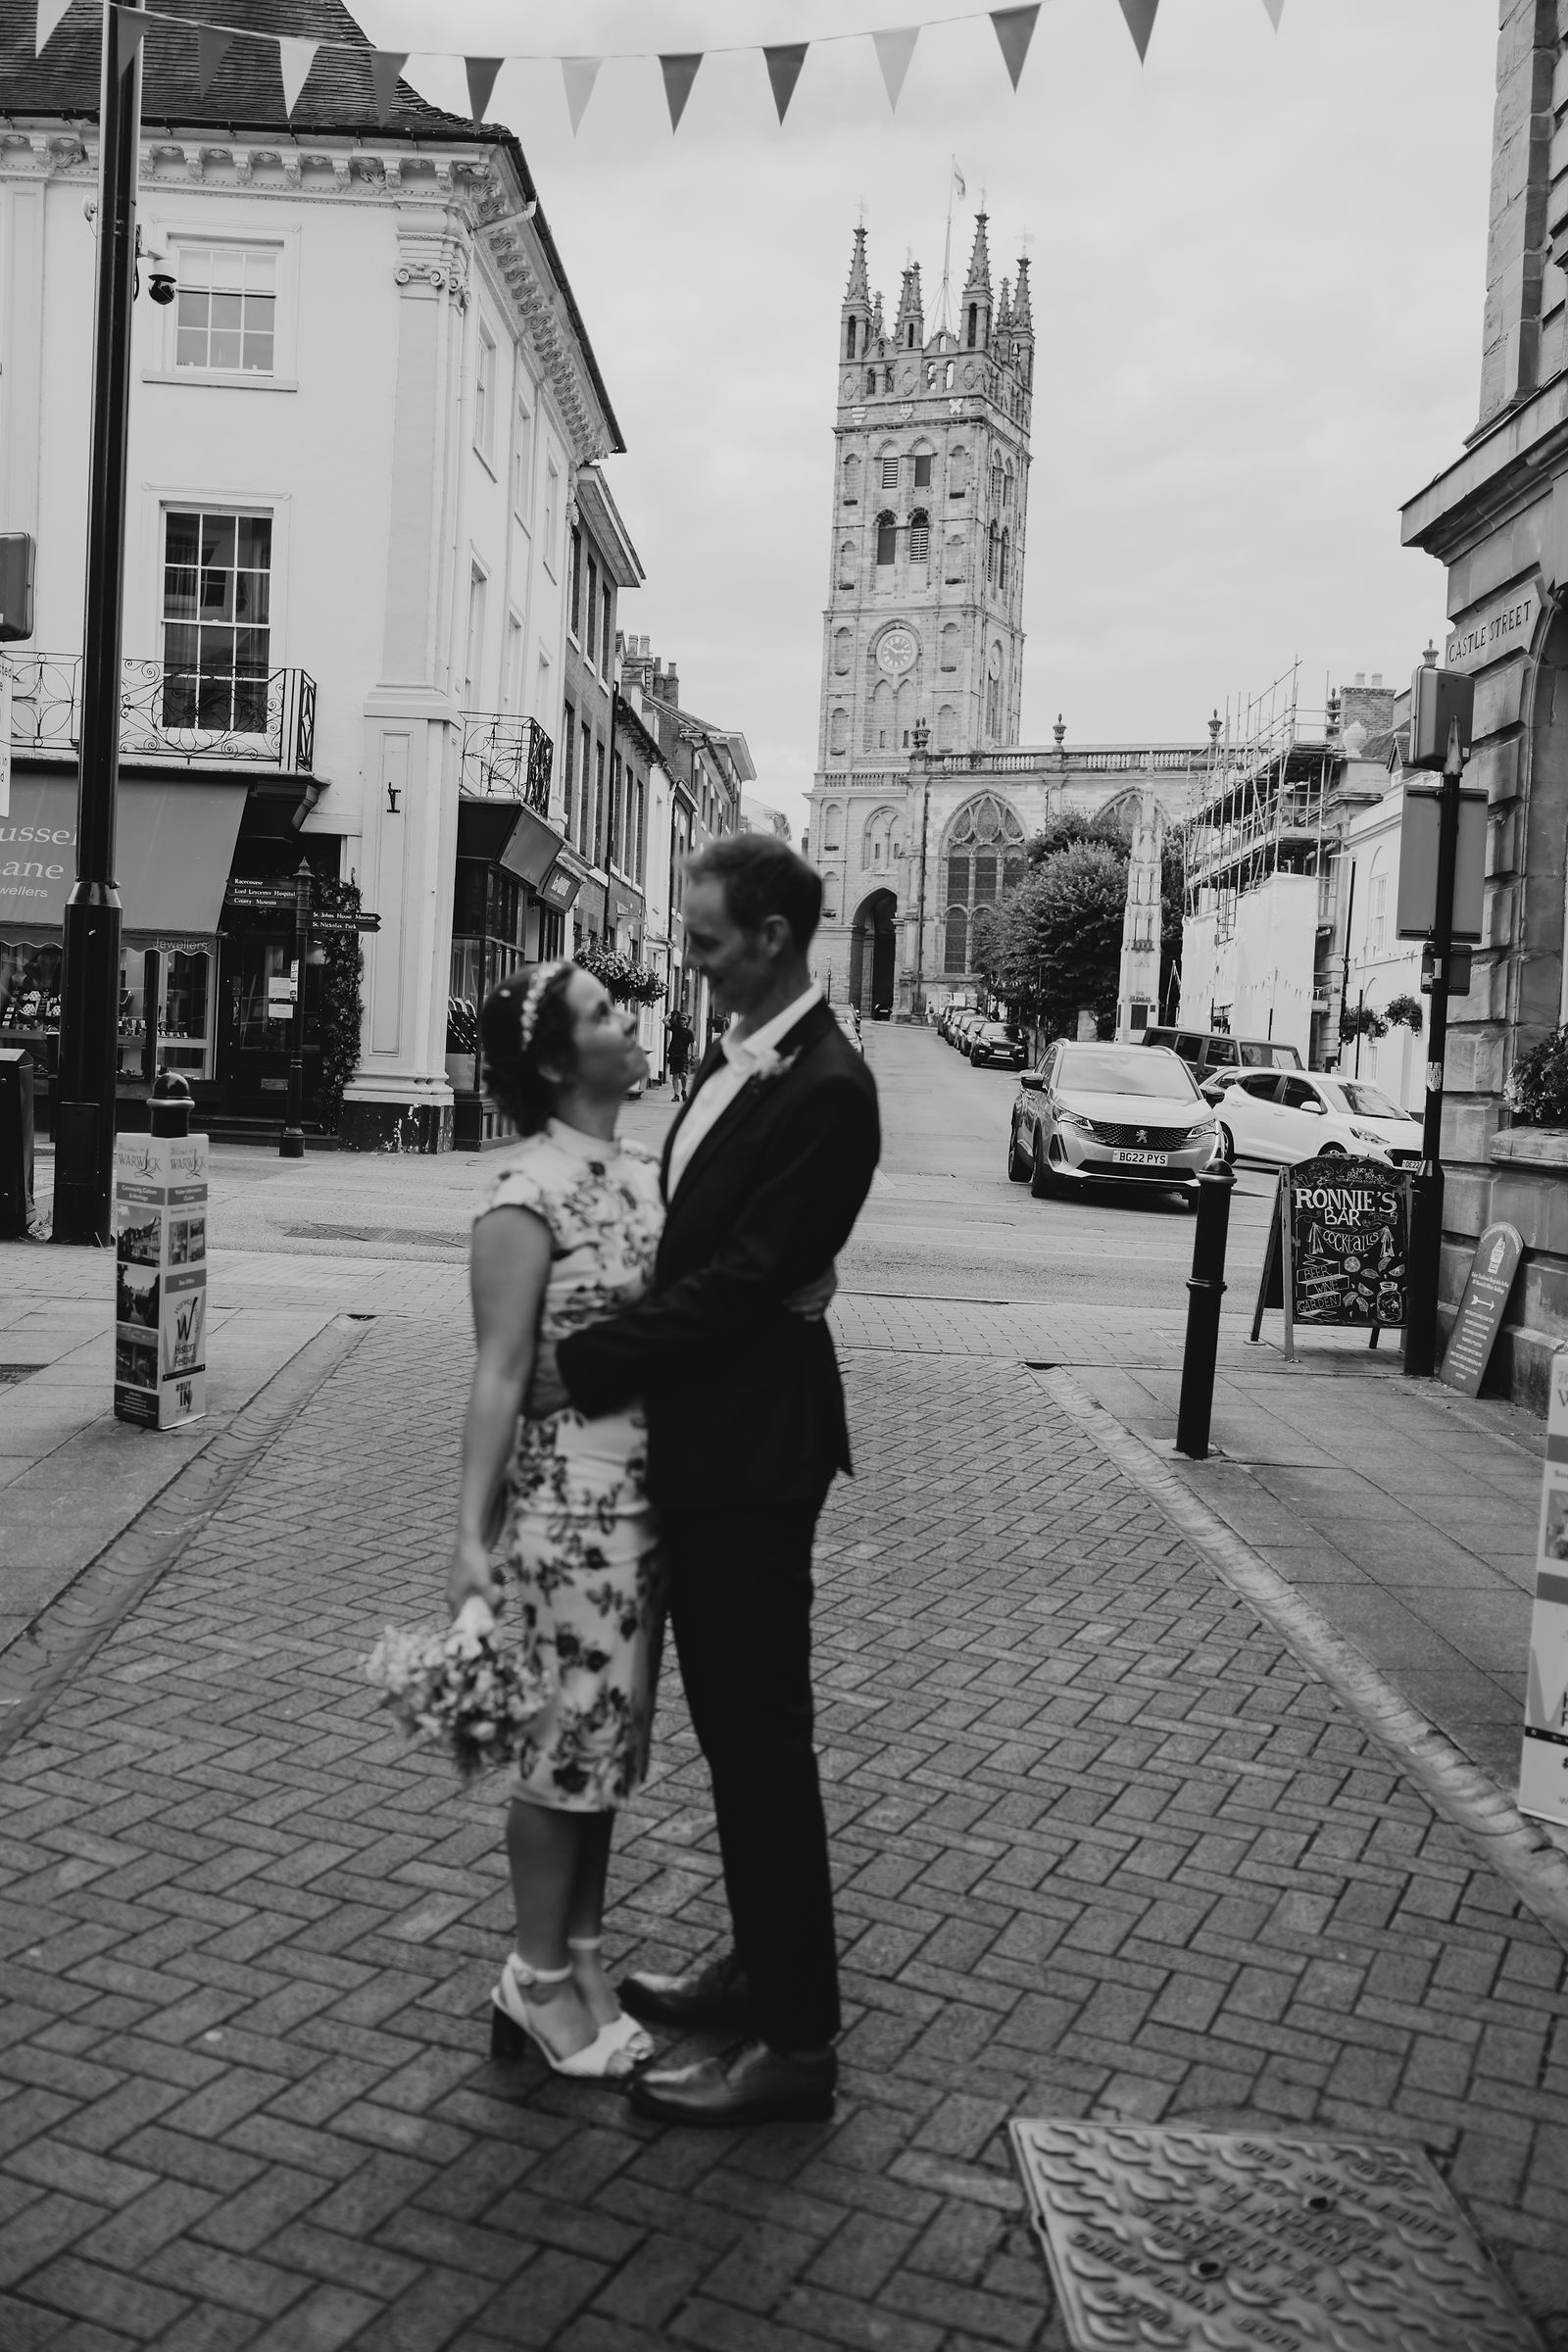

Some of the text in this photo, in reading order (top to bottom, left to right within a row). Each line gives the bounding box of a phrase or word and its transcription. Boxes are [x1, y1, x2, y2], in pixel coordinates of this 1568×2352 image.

[1448, 600, 1532, 662] CASTLE STREET
[0, 859, 64, 879] ane
[0, 885, 48, 898] wellers
[234, 897, 252, 906] County
[153, 938, 208, 951] Jewellers
[119, 1149, 162, 1179] WARWICK
[1119, 1152, 1166, 1164] BG22 PYS
[1404, 1160, 1420, 1169] DE22
[1295, 1188, 1397, 1213] RONNIE'S
[1325, 1207, 1361, 1226] BAR
[1303, 1265, 1332, 1280] BEER
[1314, 1278, 1339, 1294] WINE
[1298, 1295, 1338, 1312] GARDEN
[174, 1342, 196, 1356] History
[1068, 2232, 1226, 2316] CHIEFTAIN
